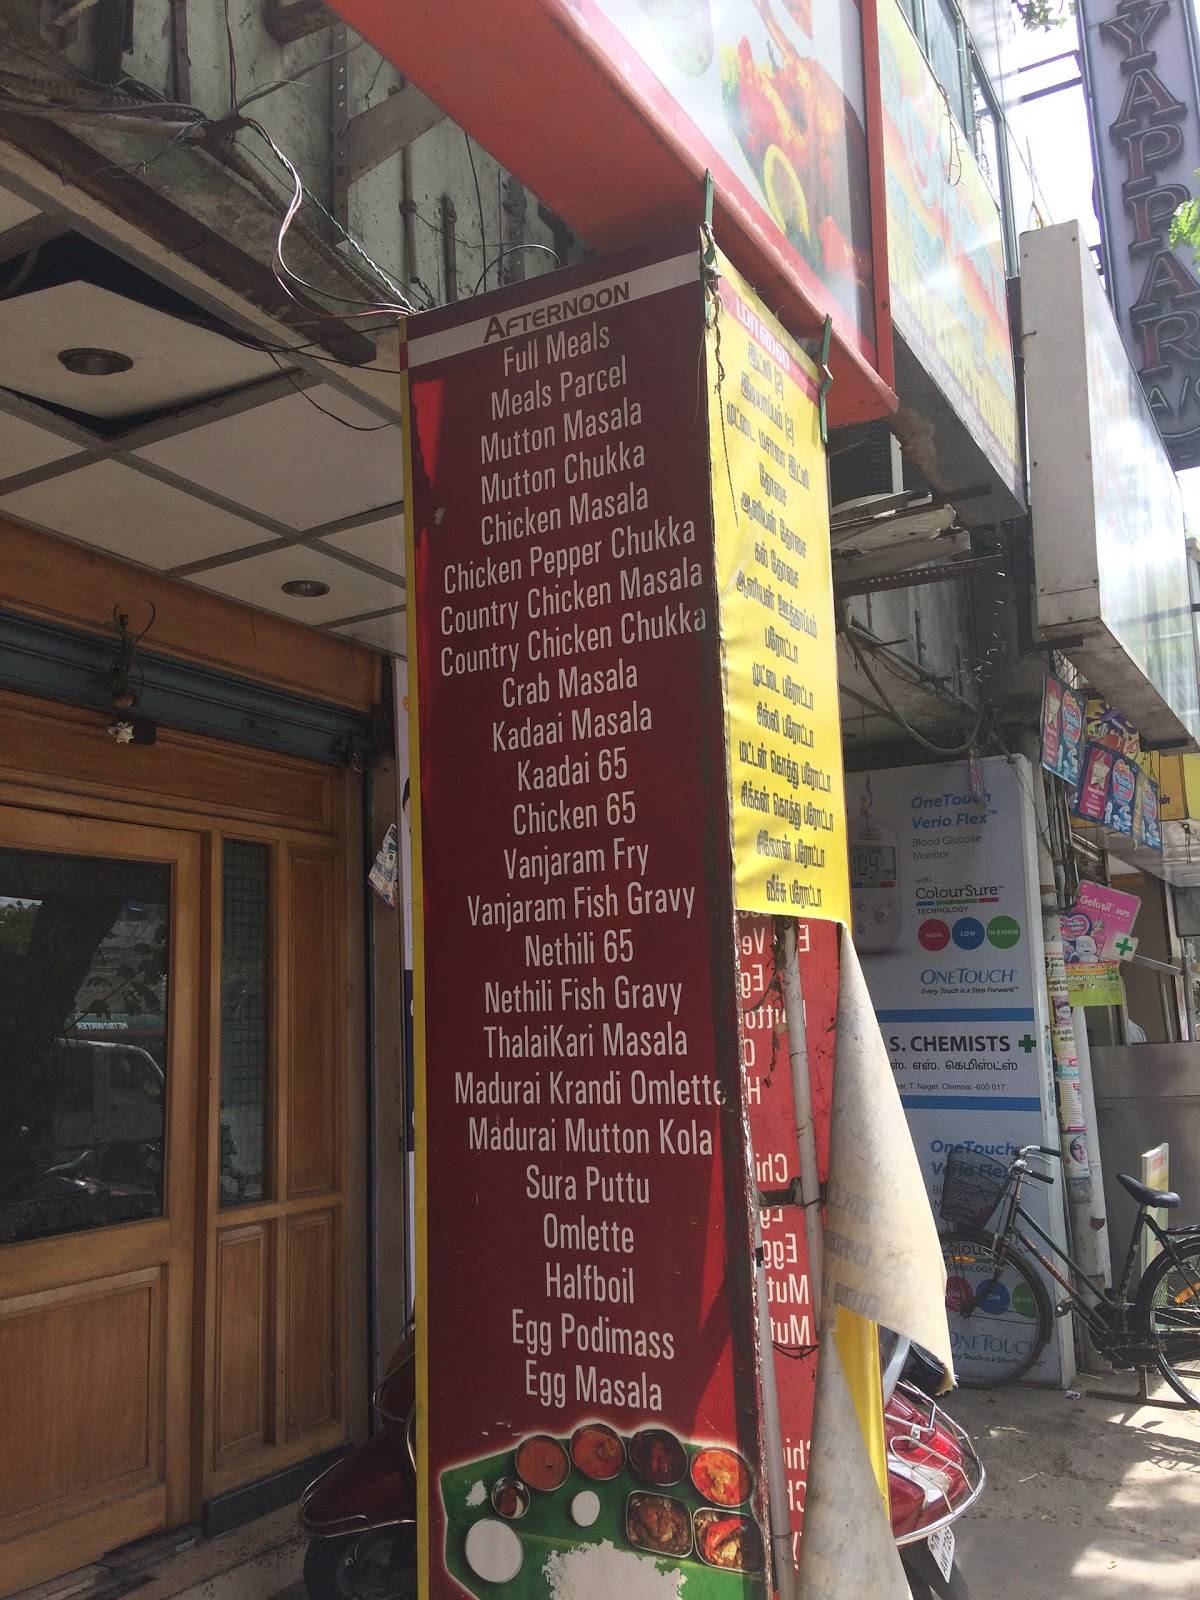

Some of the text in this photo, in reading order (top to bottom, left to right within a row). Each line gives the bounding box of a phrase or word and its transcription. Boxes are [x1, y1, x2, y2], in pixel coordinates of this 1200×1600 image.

[484, 282, 630, 343] AFTERNOON
[504, 322, 610, 376] Full Meals
[491, 355, 627, 421] Meals Parcel
[480, 402, 642, 464] Mutton Masala
[481, 441, 646, 505] Mutton Chukka
[481, 483, 649, 546] Chicken Masala
[444, 516, 696, 595] Chicken Pepper Chukka
[441, 557, 703, 636] Country Chicken Masala
[441, 602, 707, 677] Country Chicken Chukka
[502, 657, 639, 709] Crab Masala
[492, 700, 652, 752] Kadaai Masala
[517, 746, 628, 792] Kaadai 65
[513, 790, 636, 836] Chicken 65
[912, 813, 951, 831] Verio
[503, 836, 649, 885] Vanjaram Fry
[912, 832, 982, 849] Blood Glucose
[913, 849, 950, 861] Monitor
[467, 881, 696, 932] Vanjaram Fish Gravy
[917, 905, 969, 915] TECHNOLOGY
[1080, 894, 1113, 912] Gelusil
[525, 928, 634, 967] Nethili 65
[959, 929, 977, 938] LOW
[484, 975, 683, 1016] Nethili Fish Gravy
[921, 986, 939, 996] Every
[940, 986, 959, 995] Touch
[483, 1021, 688, 1059] ThalaiKari Masala
[911, 1035, 1011, 1053] CHEMISTS
[454, 1070, 541, 1105] Madurai
[549, 1070, 622, 1105] Krandi
[630, 1069, 727, 1106] Omlette
[942, 1082, 972, 1091] Chennai
[468, 1116, 713, 1156] Madurai Mutton Kola
[526, 1164, 650, 1204] Sura Puttu
[543, 1213, 634, 1254] Omlette
[545, 1262, 635, 1304] Halfboil
[512, 1308, 675, 1360] Egg Podimass
[525, 1359, 662, 1411] Egg Masala
